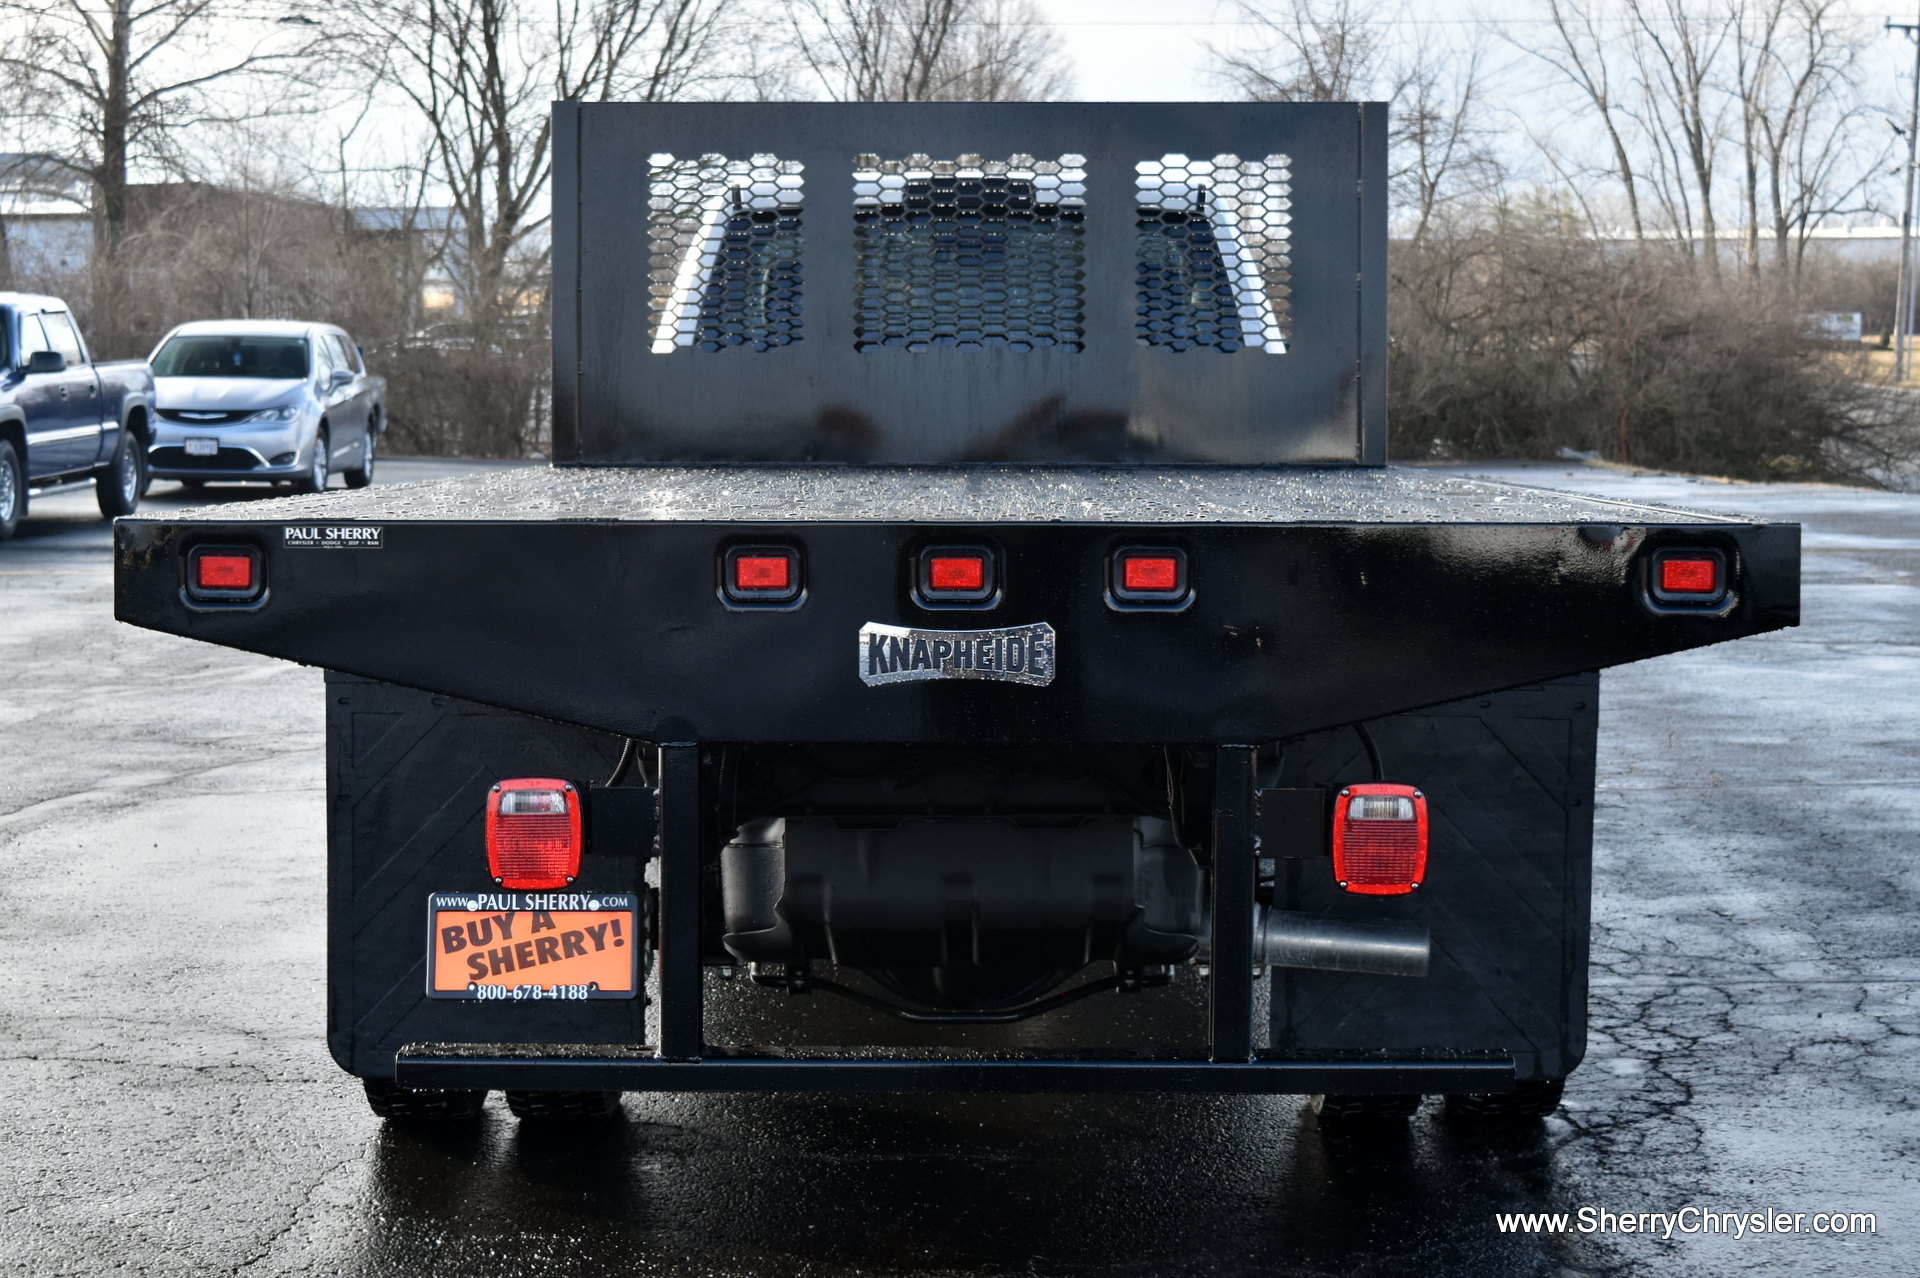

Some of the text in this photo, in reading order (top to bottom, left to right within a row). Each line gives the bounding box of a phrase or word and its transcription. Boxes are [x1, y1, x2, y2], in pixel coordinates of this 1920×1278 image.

[285, 527, 381, 540] PAUL SHERRY
[868, 632, 1046, 678] KNAPHEIDE
[478, 894, 520, 910] PAUL
[525, 893, 590, 911] SHERRY
[441, 911, 556, 954] BUY A
[466, 918, 625, 981] SHERRY!
[477, 984, 588, 1000] 800-678-4188
